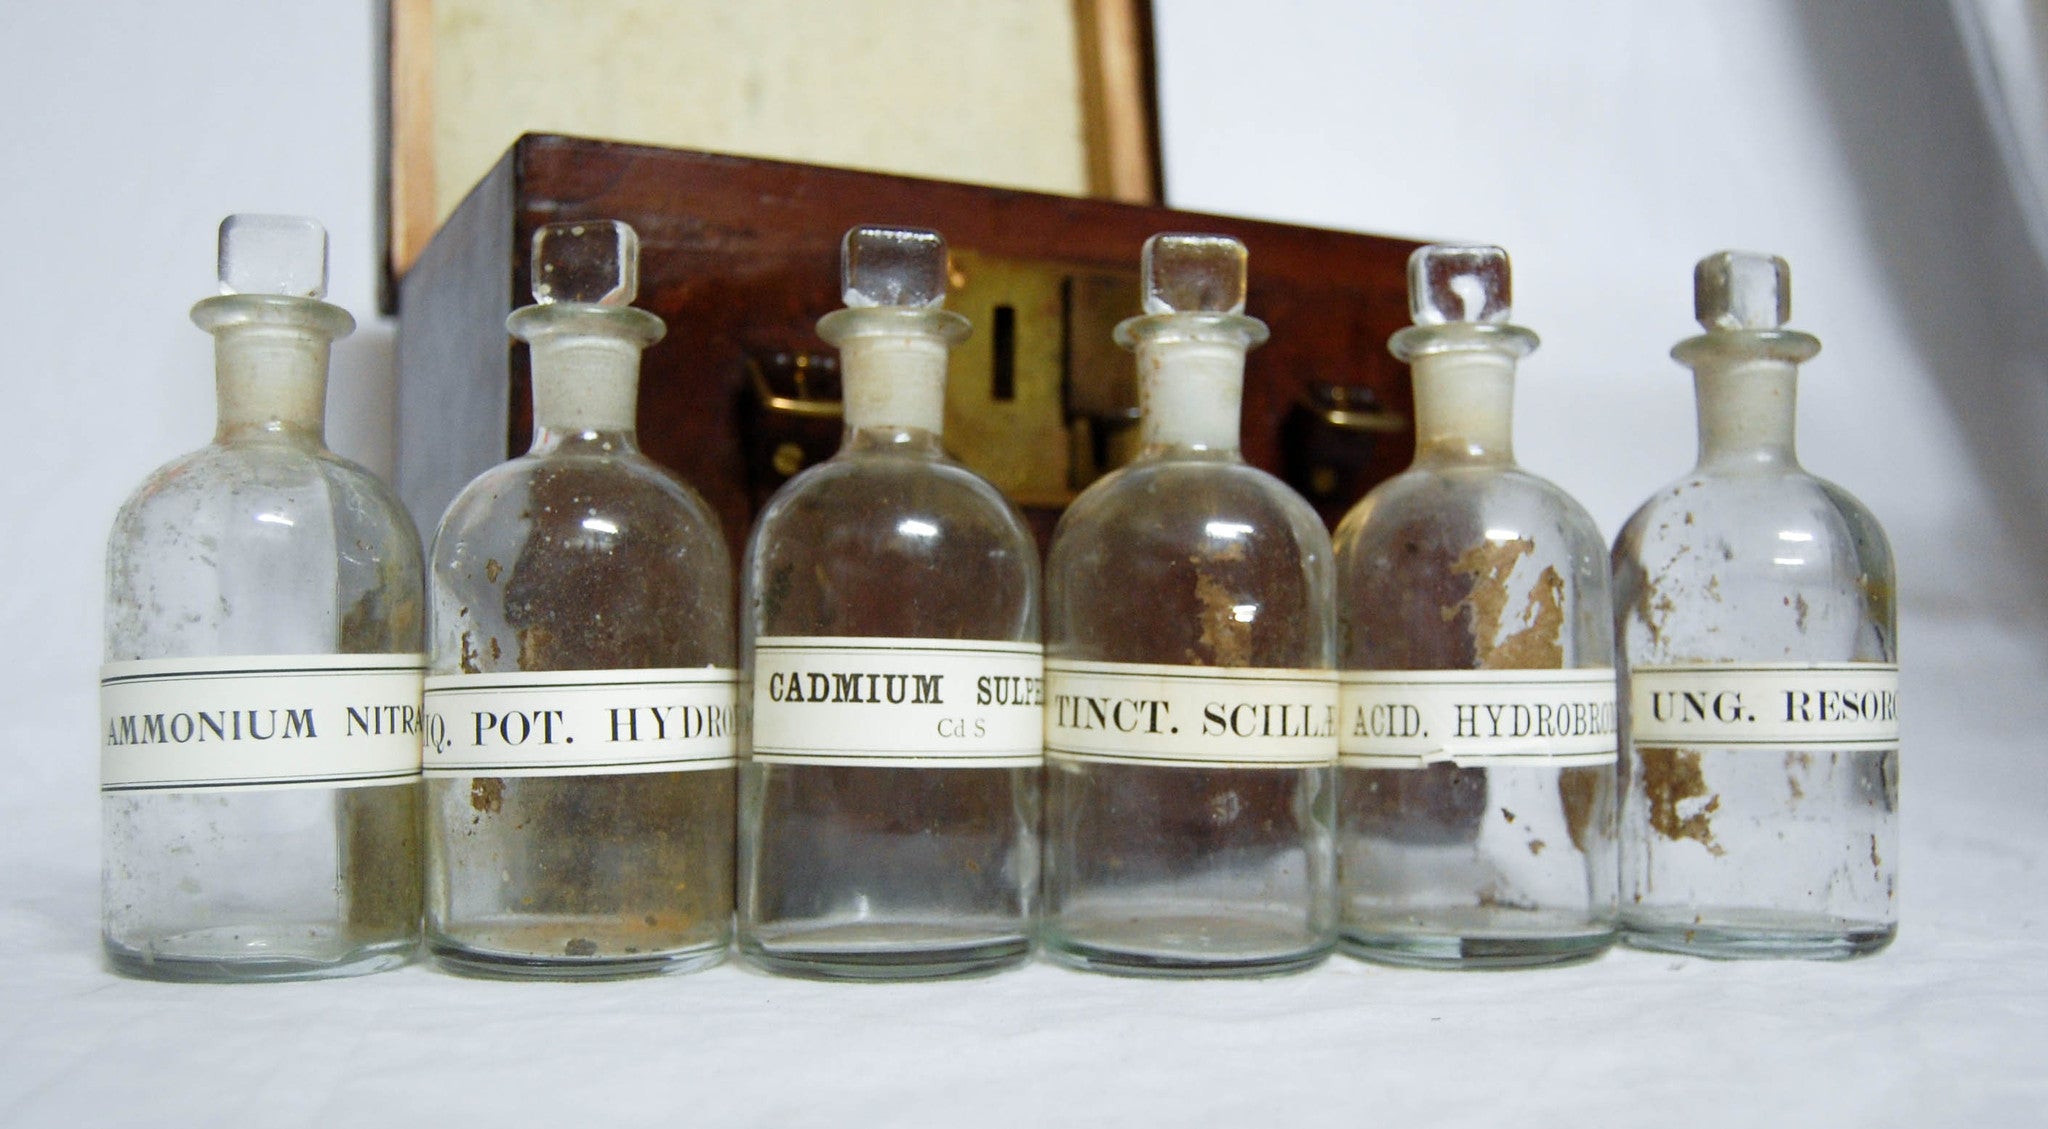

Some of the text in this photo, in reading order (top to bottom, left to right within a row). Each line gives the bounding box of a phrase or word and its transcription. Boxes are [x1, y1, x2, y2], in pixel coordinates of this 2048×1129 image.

[769, 671, 944, 705] CADMIUM
[1055, 694, 1179, 735] TINCT.
[1353, 703, 1428, 739] ACID.
[1653, 689, 1756, 724] UNG.
[107, 708, 318, 746] AMMONIUM
[424, 703, 734, 754] IQ. POT. HYDRO
[937, 717, 987, 739] Cd S
